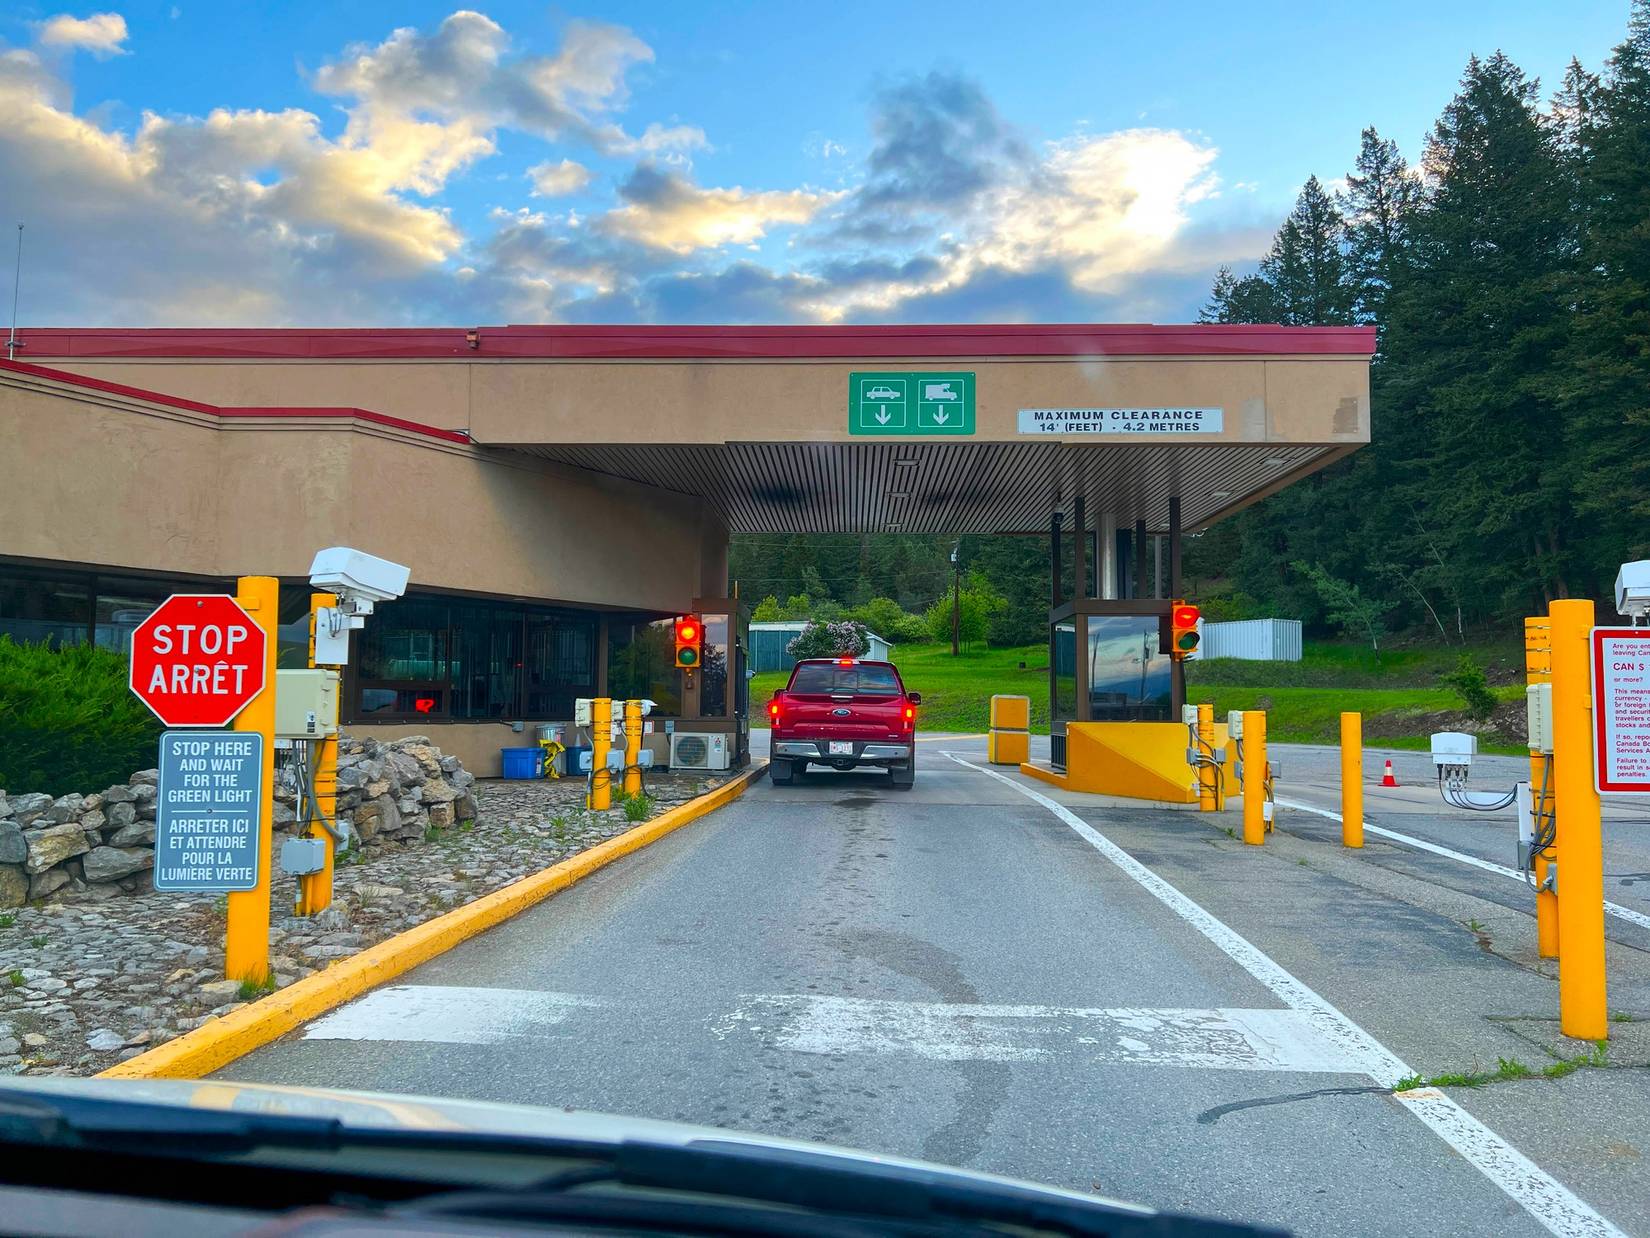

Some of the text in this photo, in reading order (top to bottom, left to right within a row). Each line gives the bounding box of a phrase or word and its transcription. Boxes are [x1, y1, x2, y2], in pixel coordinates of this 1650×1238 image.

[1034, 411, 1203, 420] MAXIMUM CLEARANCE
[1065, 421, 1103, 432] (FEET)
[1123, 422, 1145, 431] 4.2
[1149, 422, 1200, 431] METRES
[152, 624, 248, 655] STOP
[1613, 662, 1635, 671] CAN
[147, 660, 249, 695] ARRÊT
[172, 741, 252, 756] STOP HERE
[179, 759, 244, 771] AND WAIT
[183, 774, 238, 787] FOR THE
[168, 789, 253, 803] GREEN LIGHT
[169, 818, 249, 833] ARRETER ICI
[169, 836, 247, 849] ET ATTENDRE
[182, 851, 232, 865] POUR LA
[161, 866, 253, 880] LUMIÈRE VERTE
